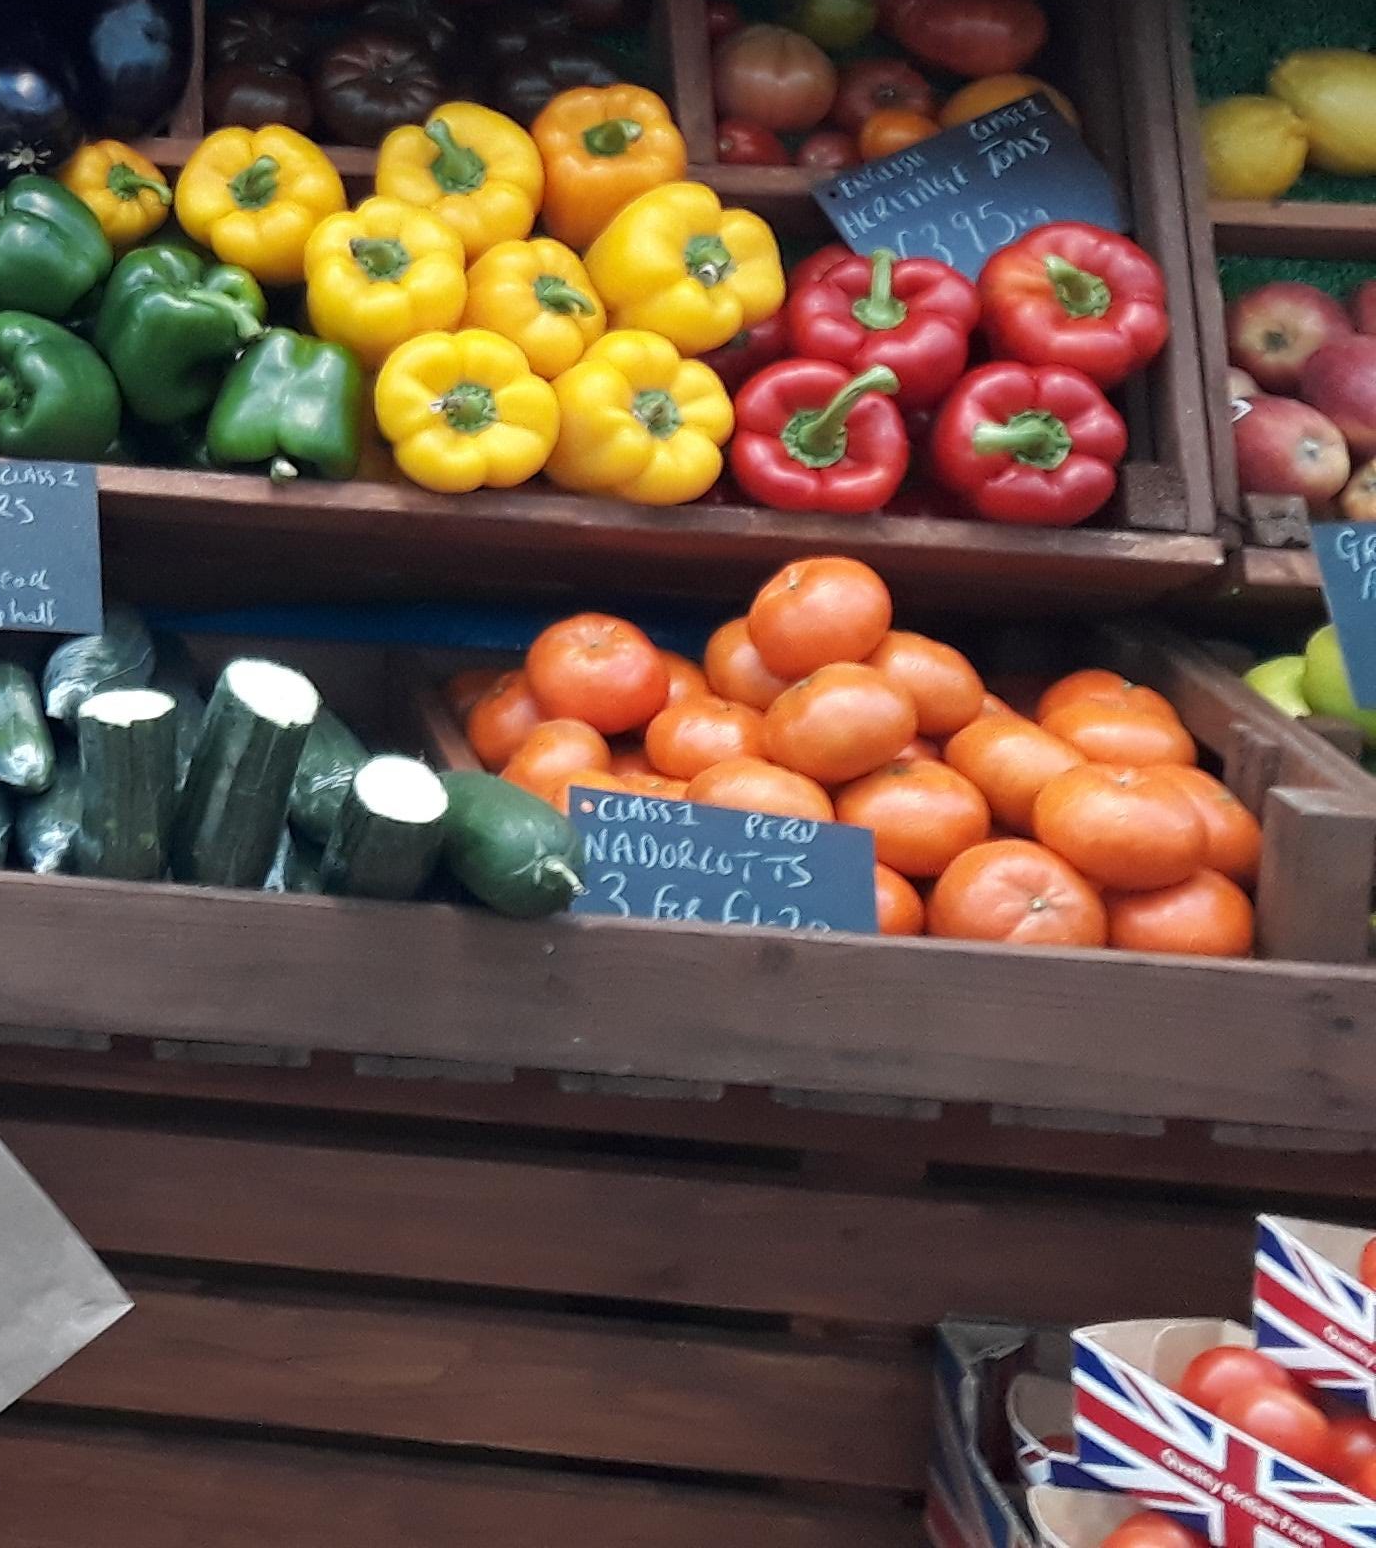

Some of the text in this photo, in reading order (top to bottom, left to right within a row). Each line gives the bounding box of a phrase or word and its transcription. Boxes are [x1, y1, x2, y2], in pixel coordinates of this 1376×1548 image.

[839, 164, 970, 240] HERITAGE
[744, 813, 820, 844] PERU
[584, 828, 814, 889] NADORCOTTS
[600, 871, 632, 918] 3
